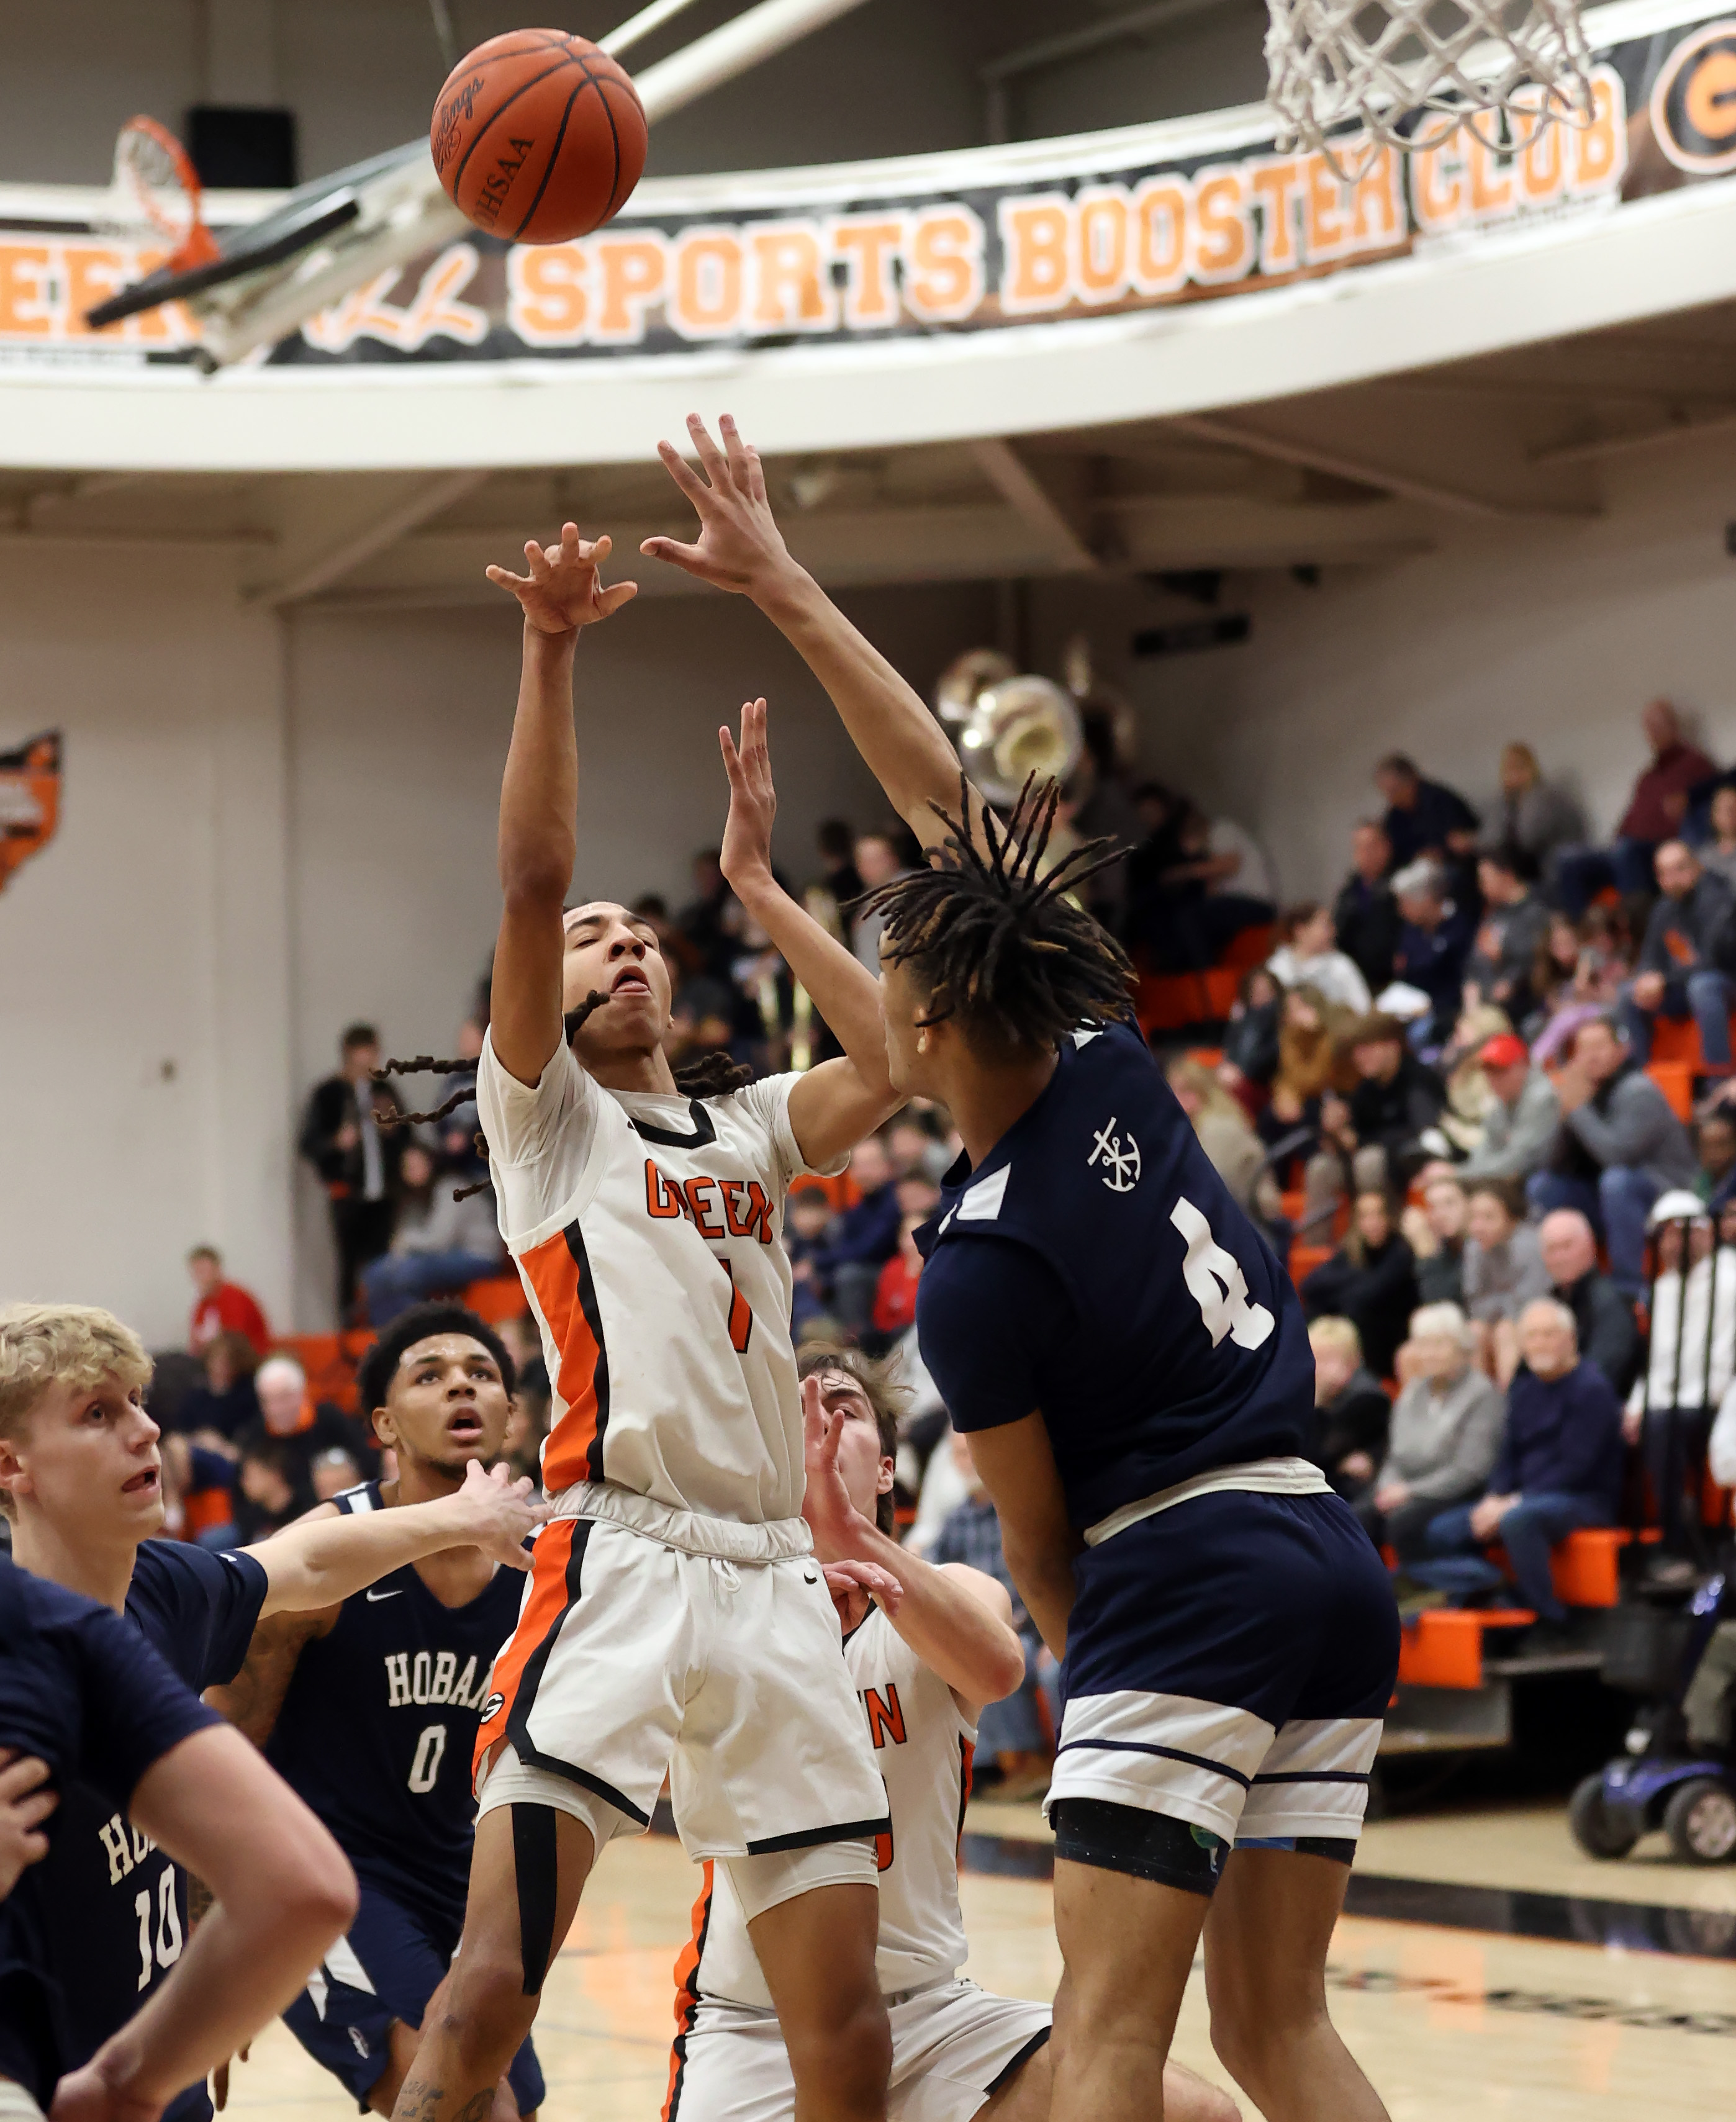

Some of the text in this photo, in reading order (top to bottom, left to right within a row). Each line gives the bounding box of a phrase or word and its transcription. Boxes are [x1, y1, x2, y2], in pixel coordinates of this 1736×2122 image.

[512, 210, 979, 343] SPORTS
[1005, 142, 1402, 305] BOOSTER
[1413, 71, 1622, 226] CLUB
[1169, 1196, 1275, 1351] 4
[407, 1724, 446, 1794] 0
[135, 1863, 183, 1992] 10
